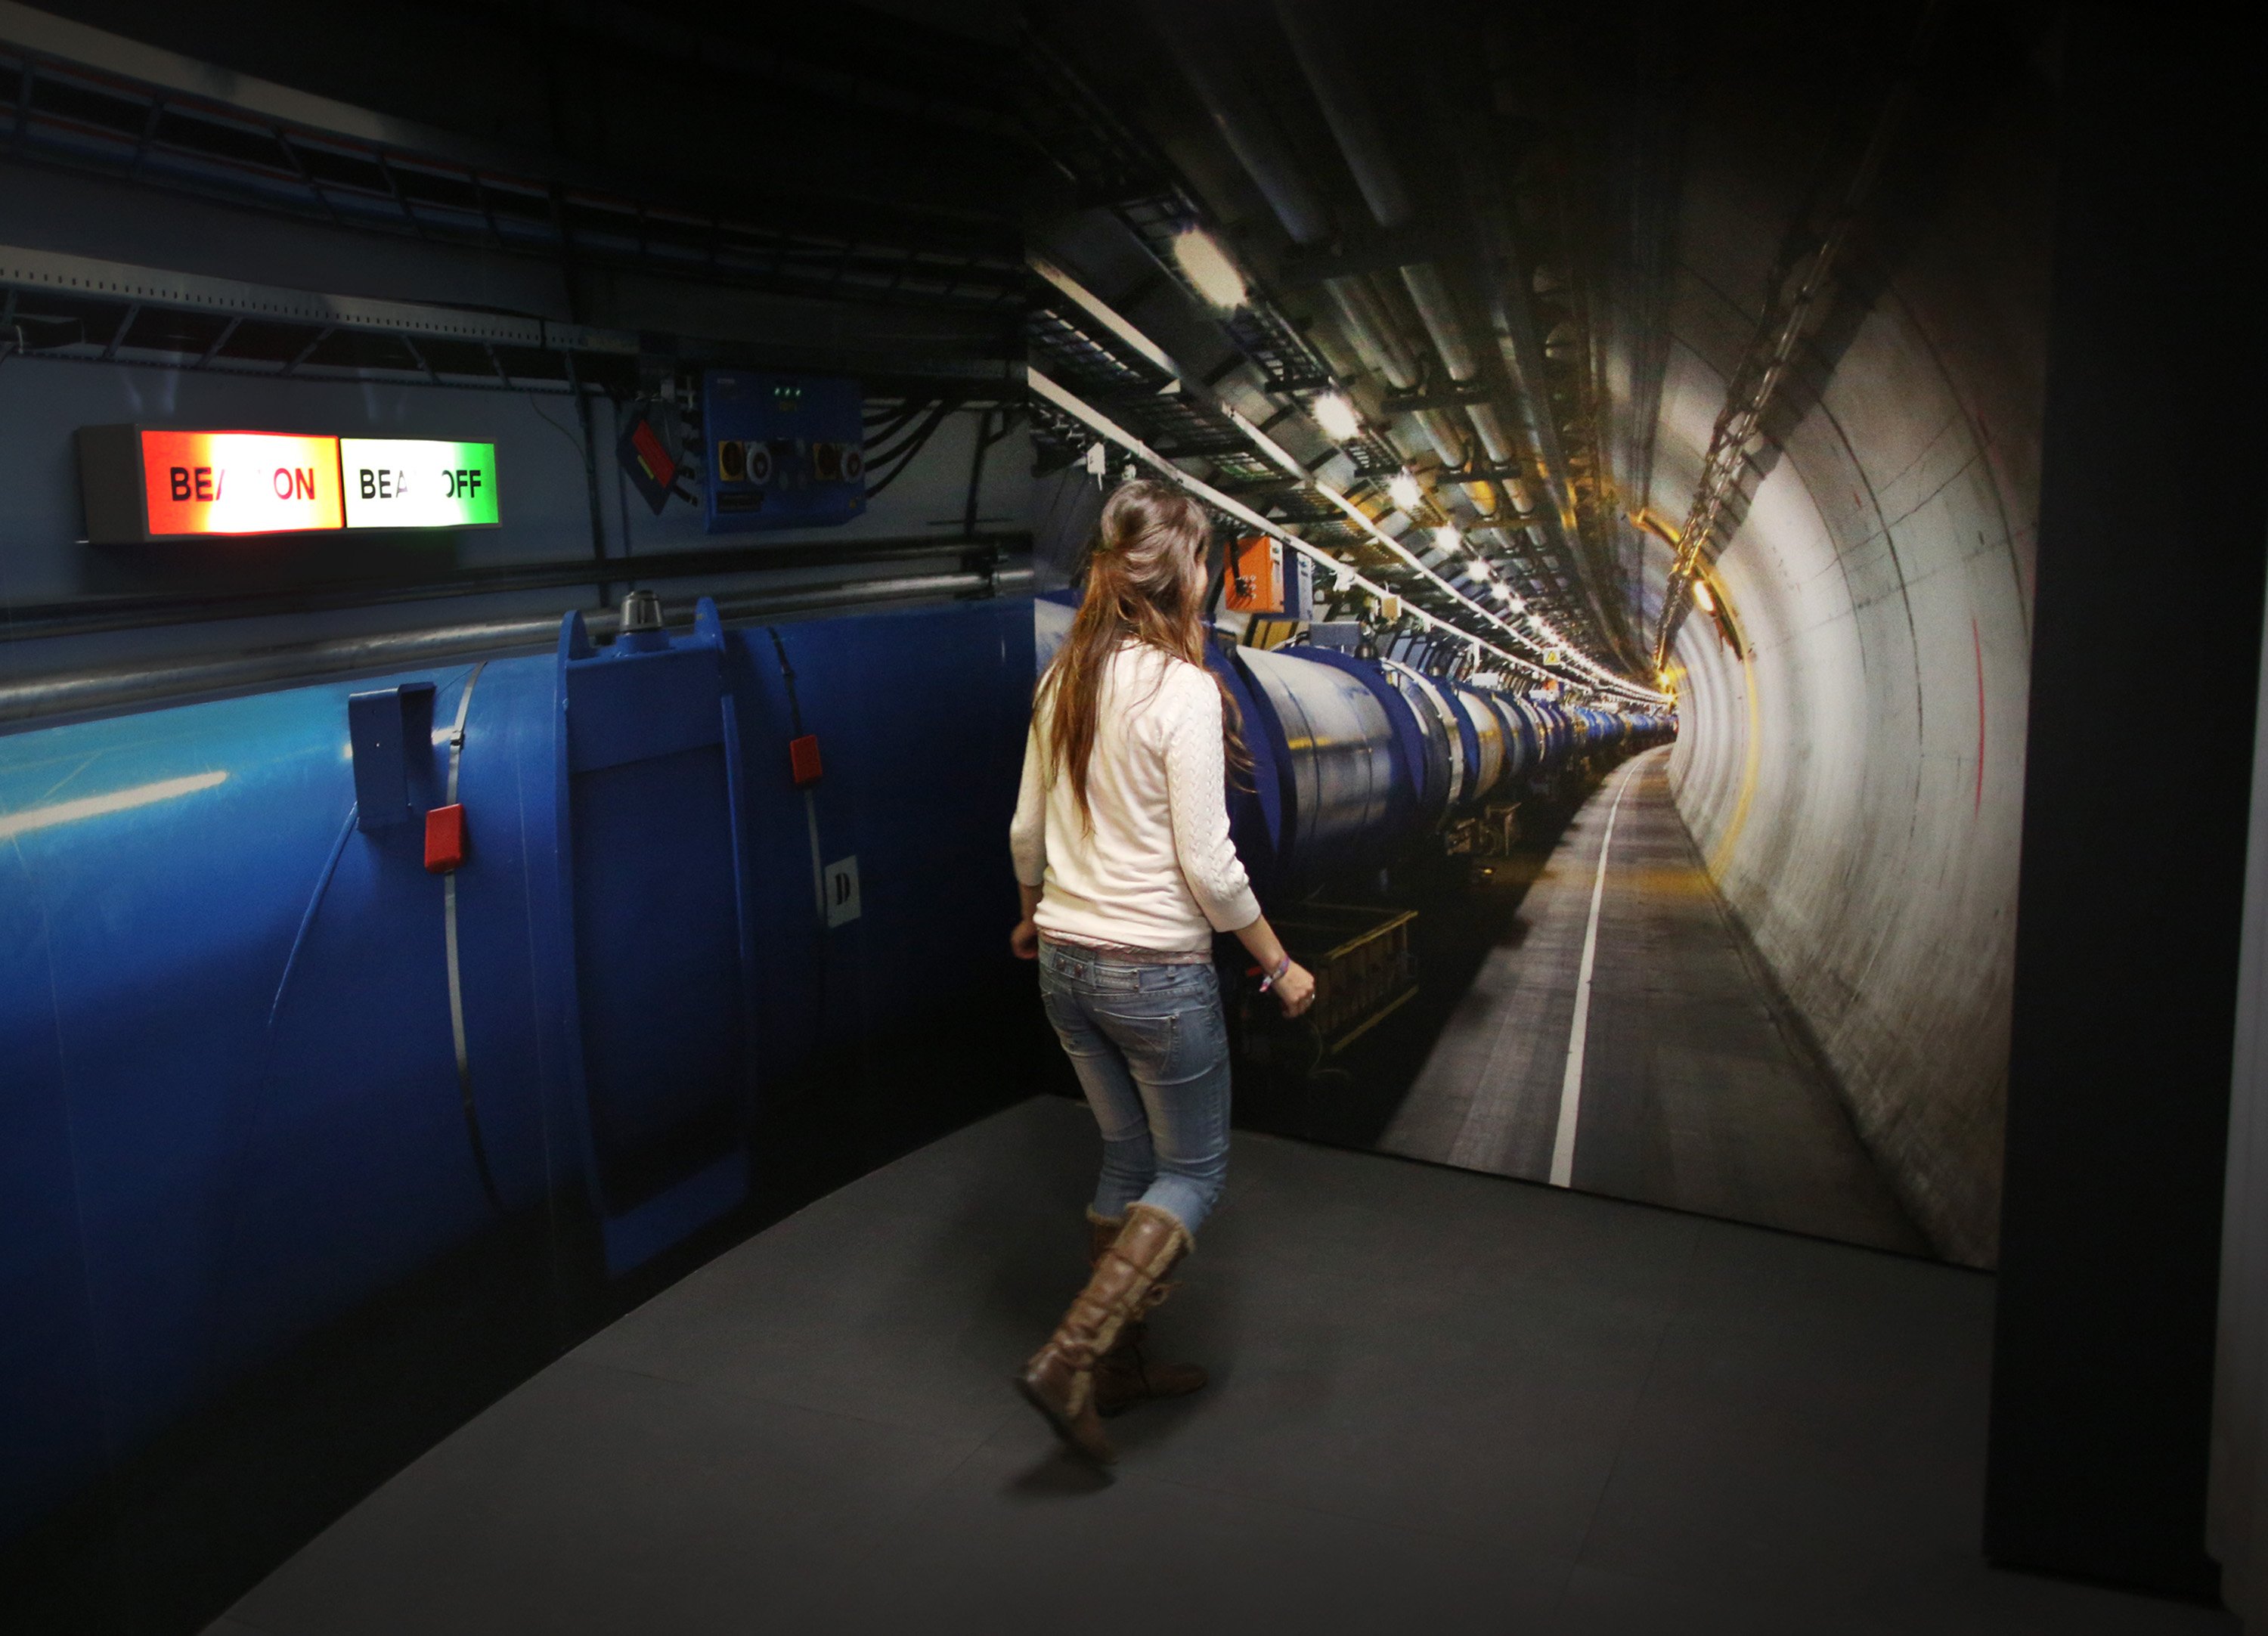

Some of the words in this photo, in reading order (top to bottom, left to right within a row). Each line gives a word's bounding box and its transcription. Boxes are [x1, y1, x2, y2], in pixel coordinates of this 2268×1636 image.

[274, 467, 315, 500] ON
[359, 469, 420, 499] BEA
[835, 873, 850, 905] D
